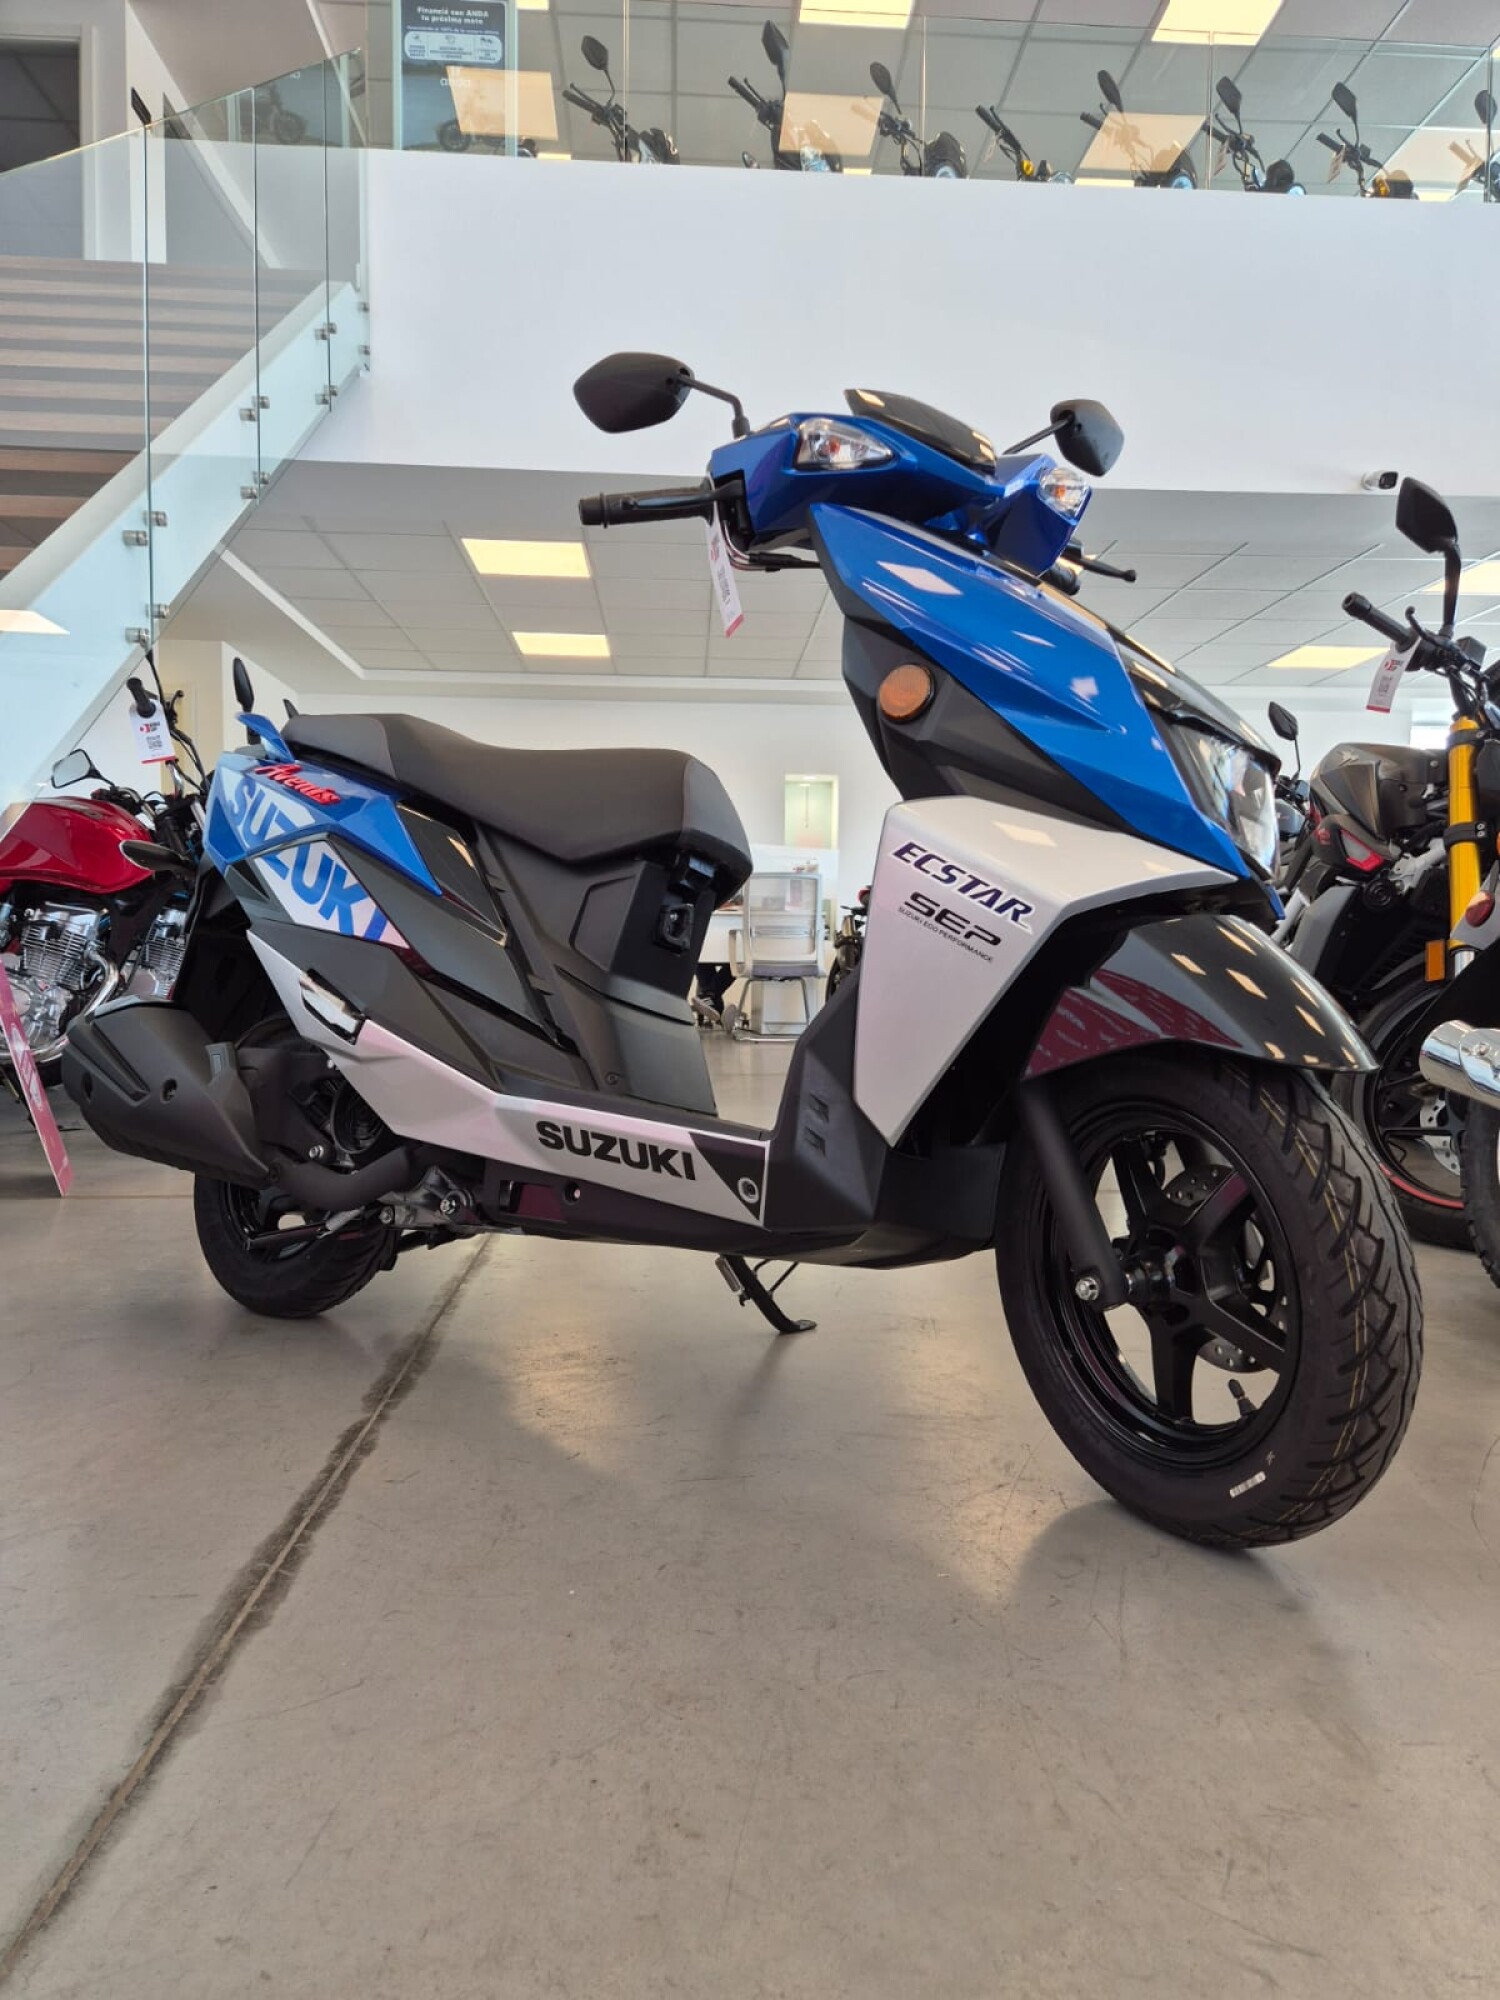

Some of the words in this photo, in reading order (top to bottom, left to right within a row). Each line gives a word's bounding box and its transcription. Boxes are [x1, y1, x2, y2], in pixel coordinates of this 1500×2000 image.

[465, 9, 489, 17] ANDA
[229, 777, 388, 942] SUZUKI
[893, 841, 1033, 931] ECSTAR
[904, 891, 1002, 946] SEP
[938, 928, 993, 963] PERFORMANCE
[535, 1120, 696, 1181] SUZUKI
